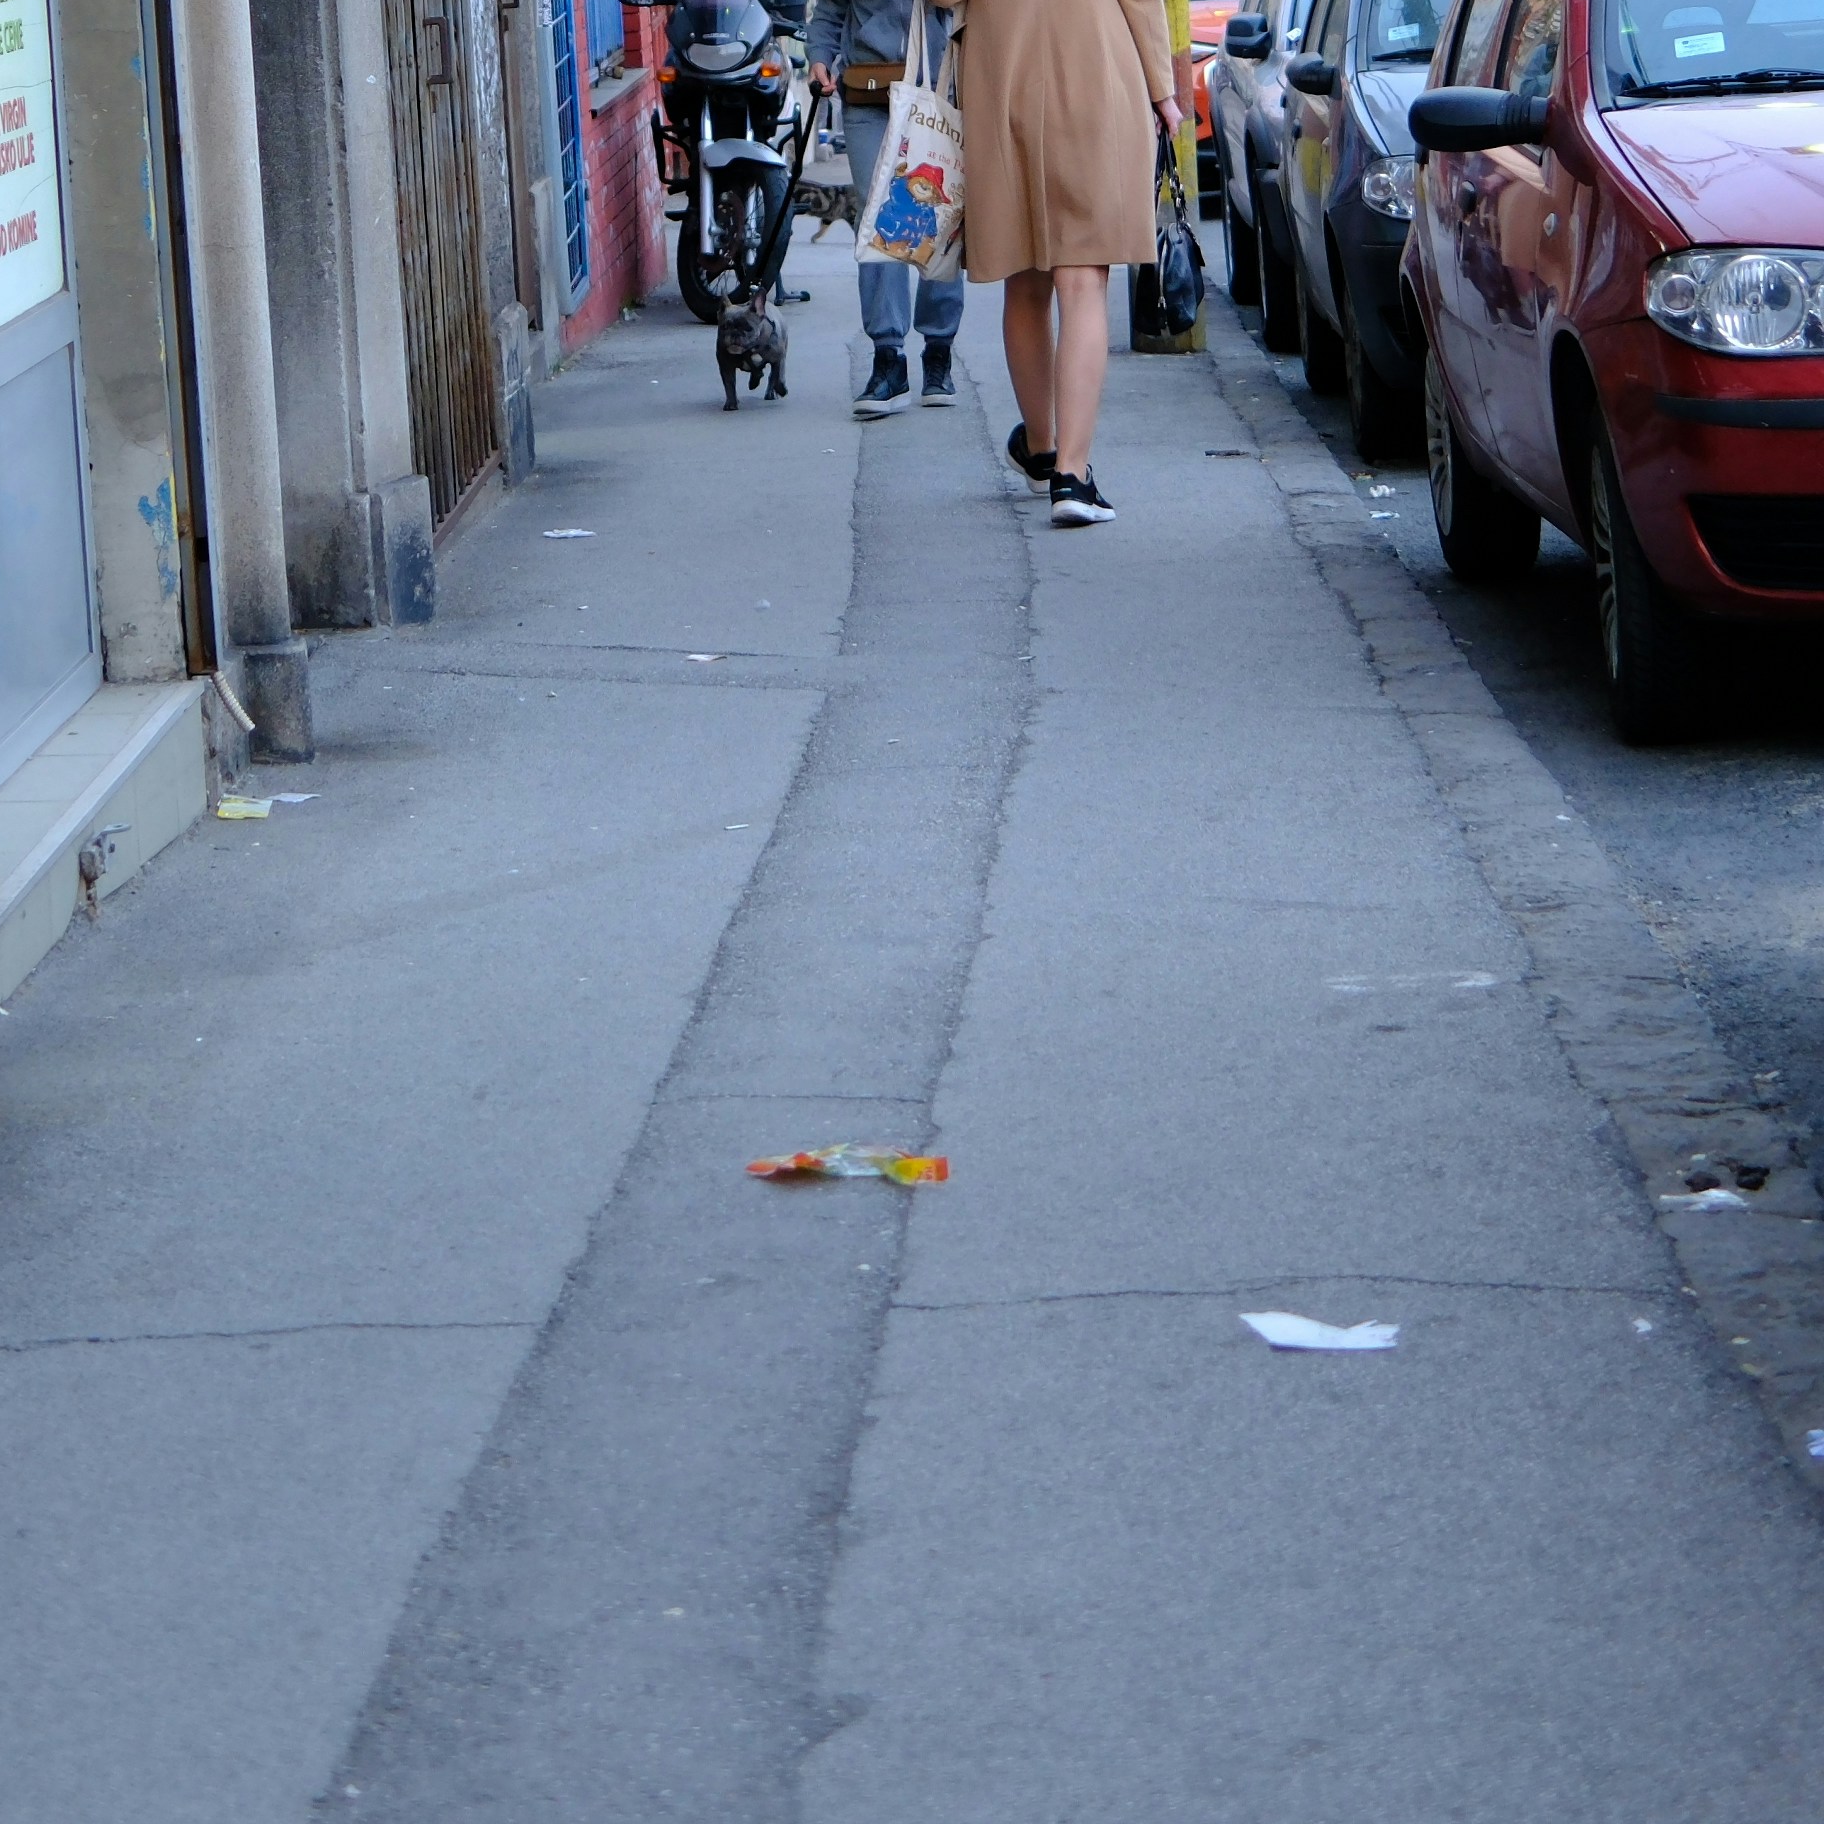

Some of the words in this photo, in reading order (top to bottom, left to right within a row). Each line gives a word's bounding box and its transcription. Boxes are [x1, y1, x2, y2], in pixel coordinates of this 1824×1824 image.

[3, 18, 25, 54] CENE
[0, 96, 28, 134] VIRGIN
[16, 131, 36, 168] ULJE
[7, 209, 39, 253] KOMINE
